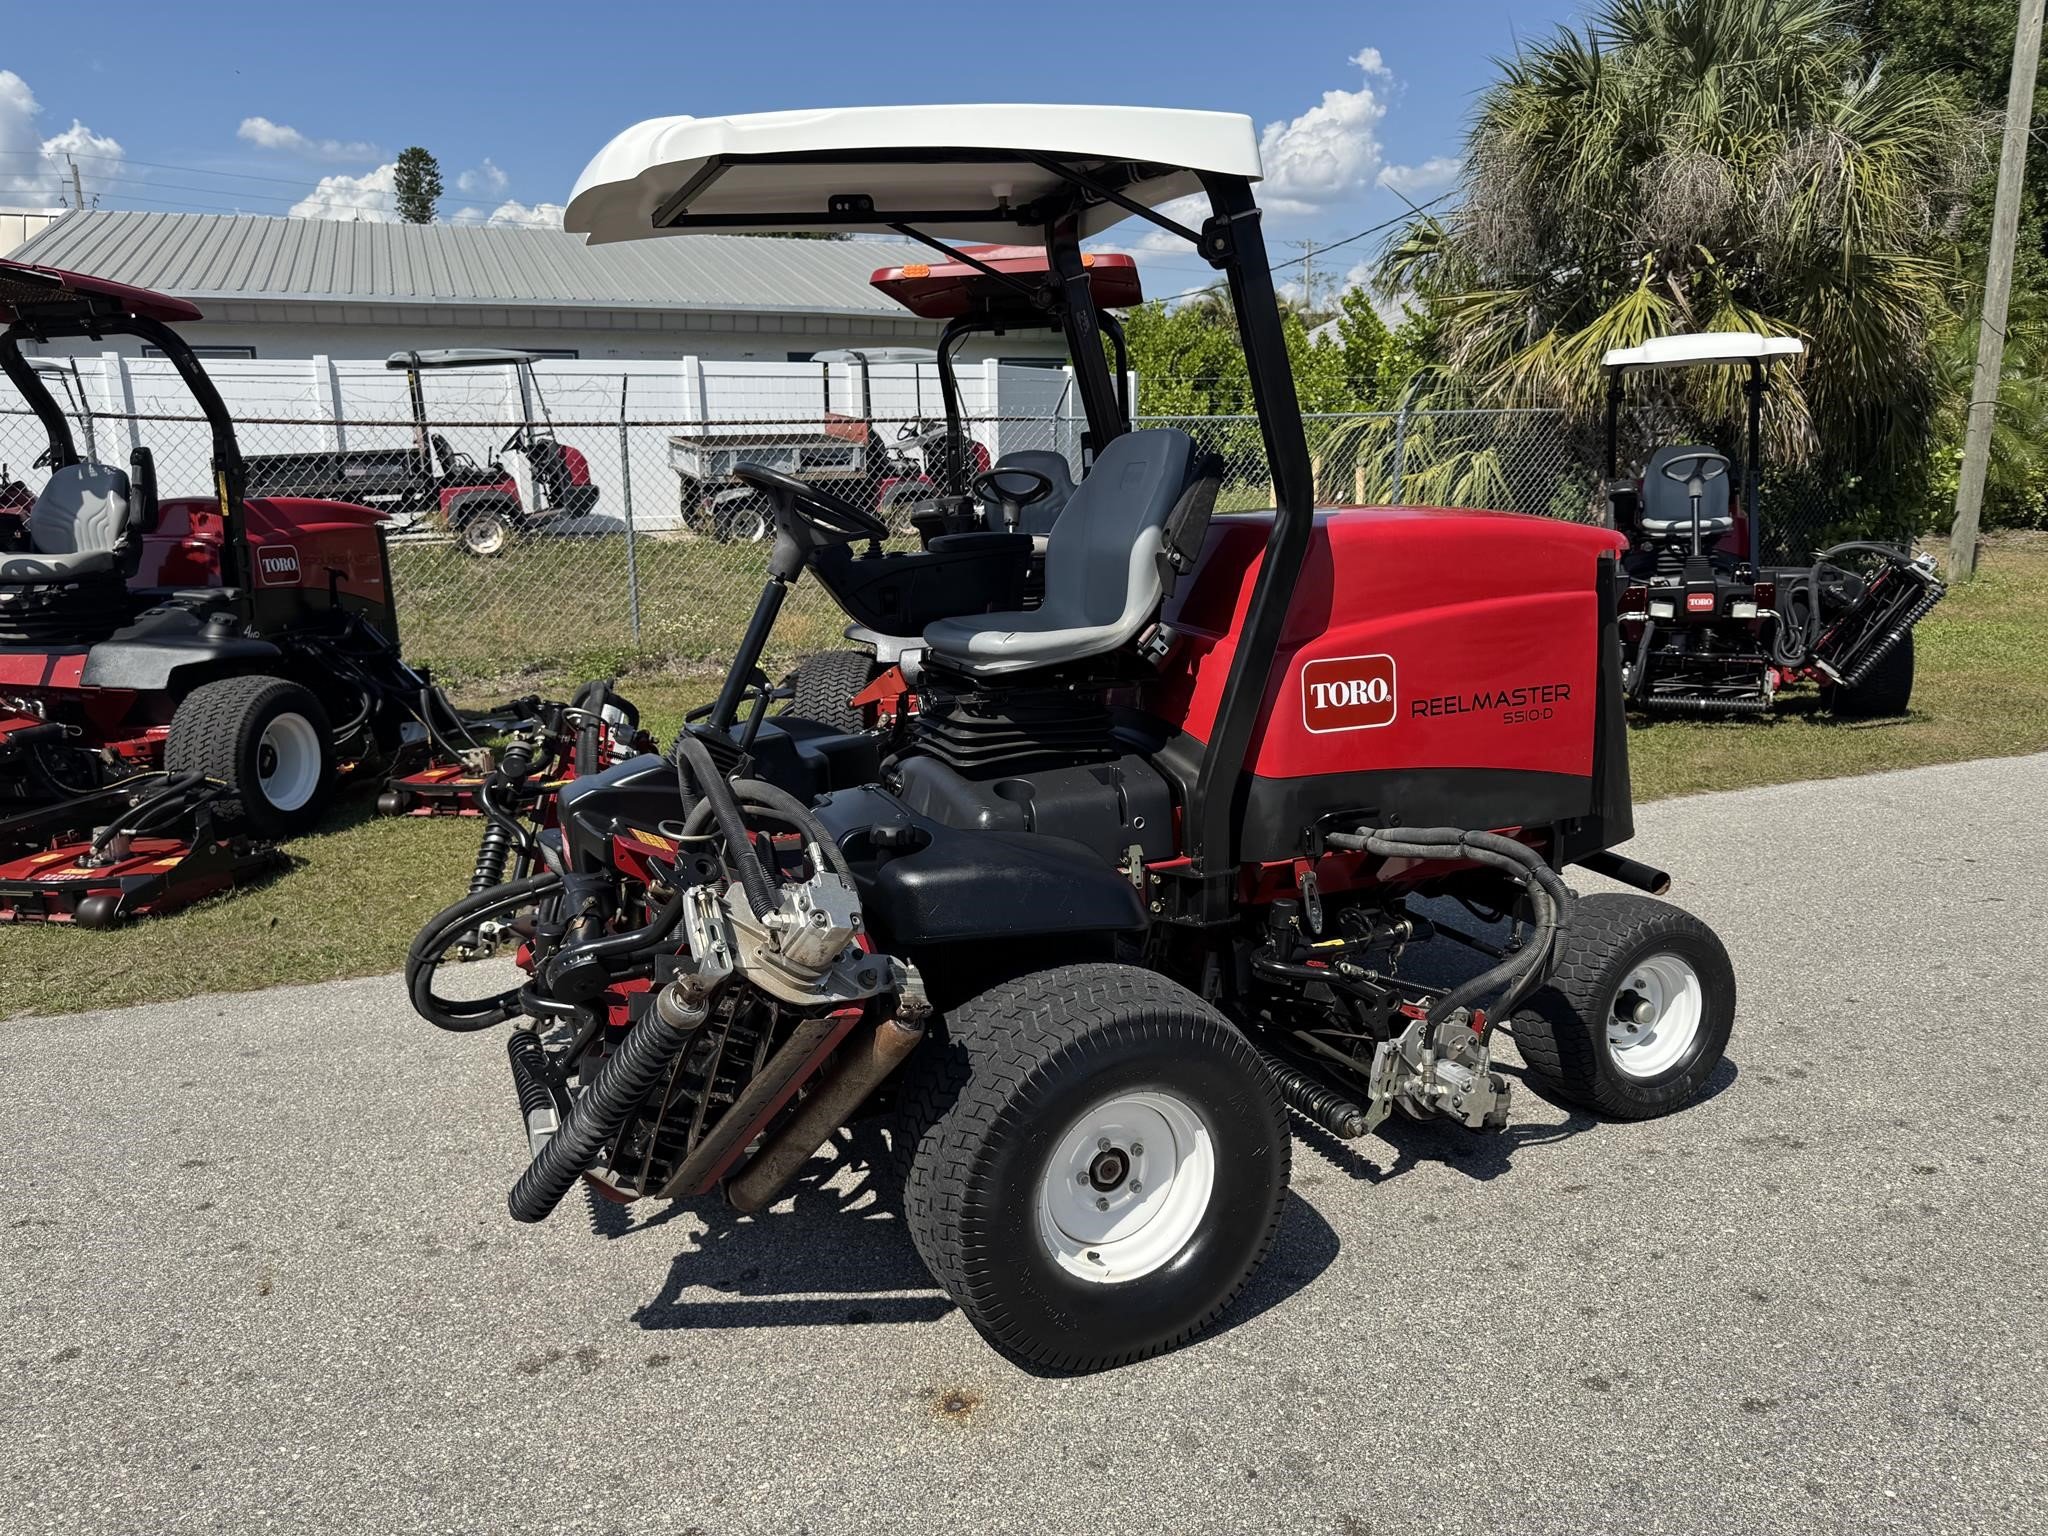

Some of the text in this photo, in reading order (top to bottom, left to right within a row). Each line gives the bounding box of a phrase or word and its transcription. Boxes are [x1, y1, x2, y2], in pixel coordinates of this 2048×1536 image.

[262, 558, 296, 573] TORO
[1690, 598, 1713, 606] TORO
[1411, 683, 1571, 718] REELMASTER
